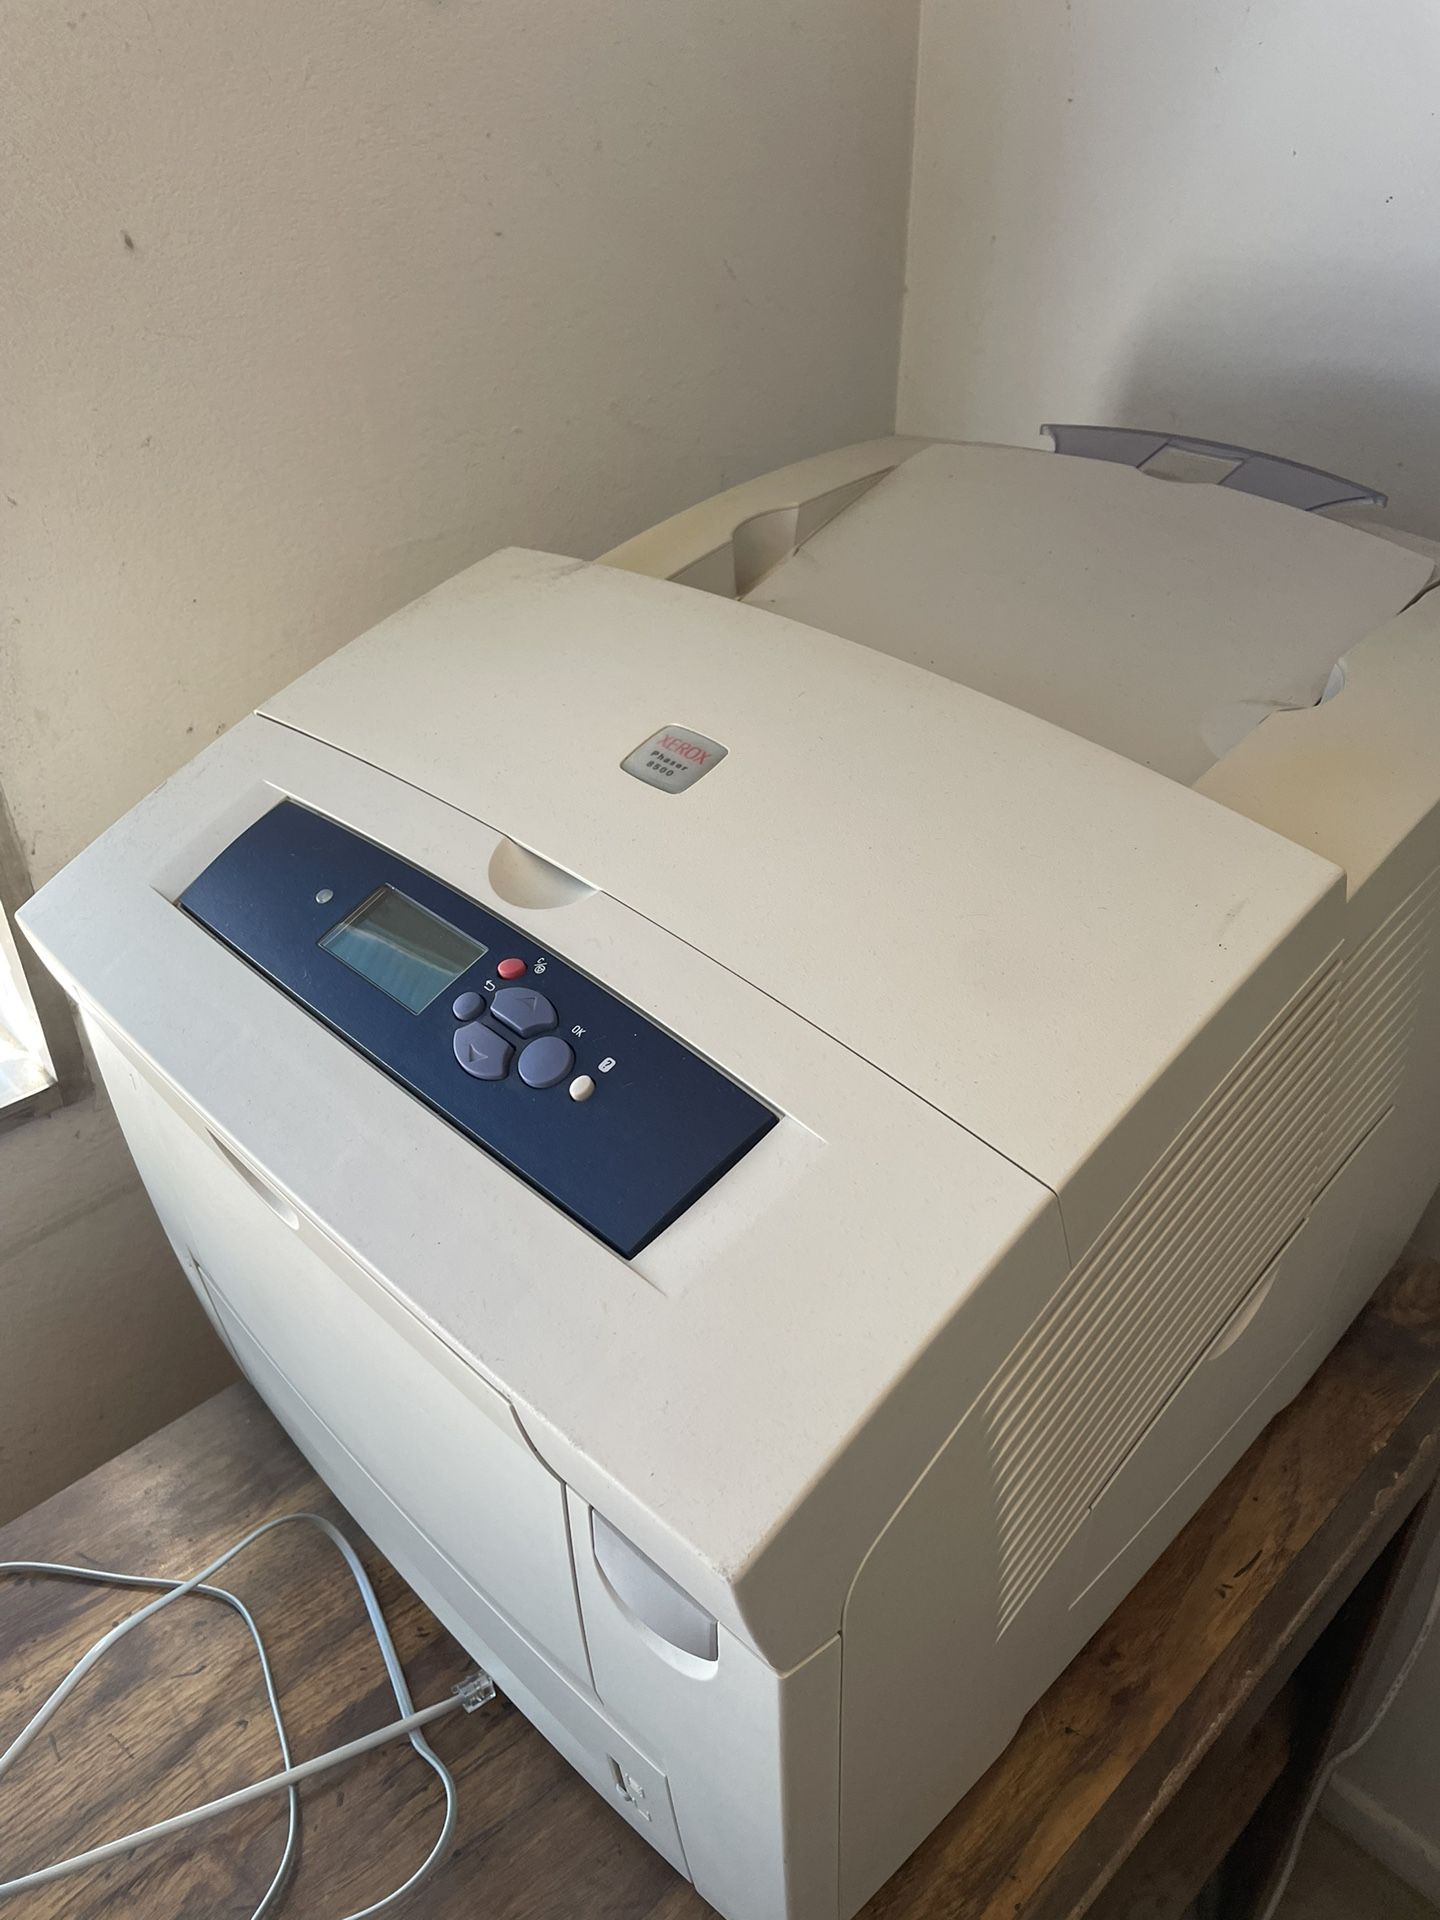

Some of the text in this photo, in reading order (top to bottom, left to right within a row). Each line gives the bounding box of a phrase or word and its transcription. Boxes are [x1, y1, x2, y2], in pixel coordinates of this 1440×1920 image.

[657, 734, 711, 765] XEROX
[646, 760, 674, 777] 8500
[650, 750, 688, 771] Phaser
[571, 1024, 586, 1038] OK
